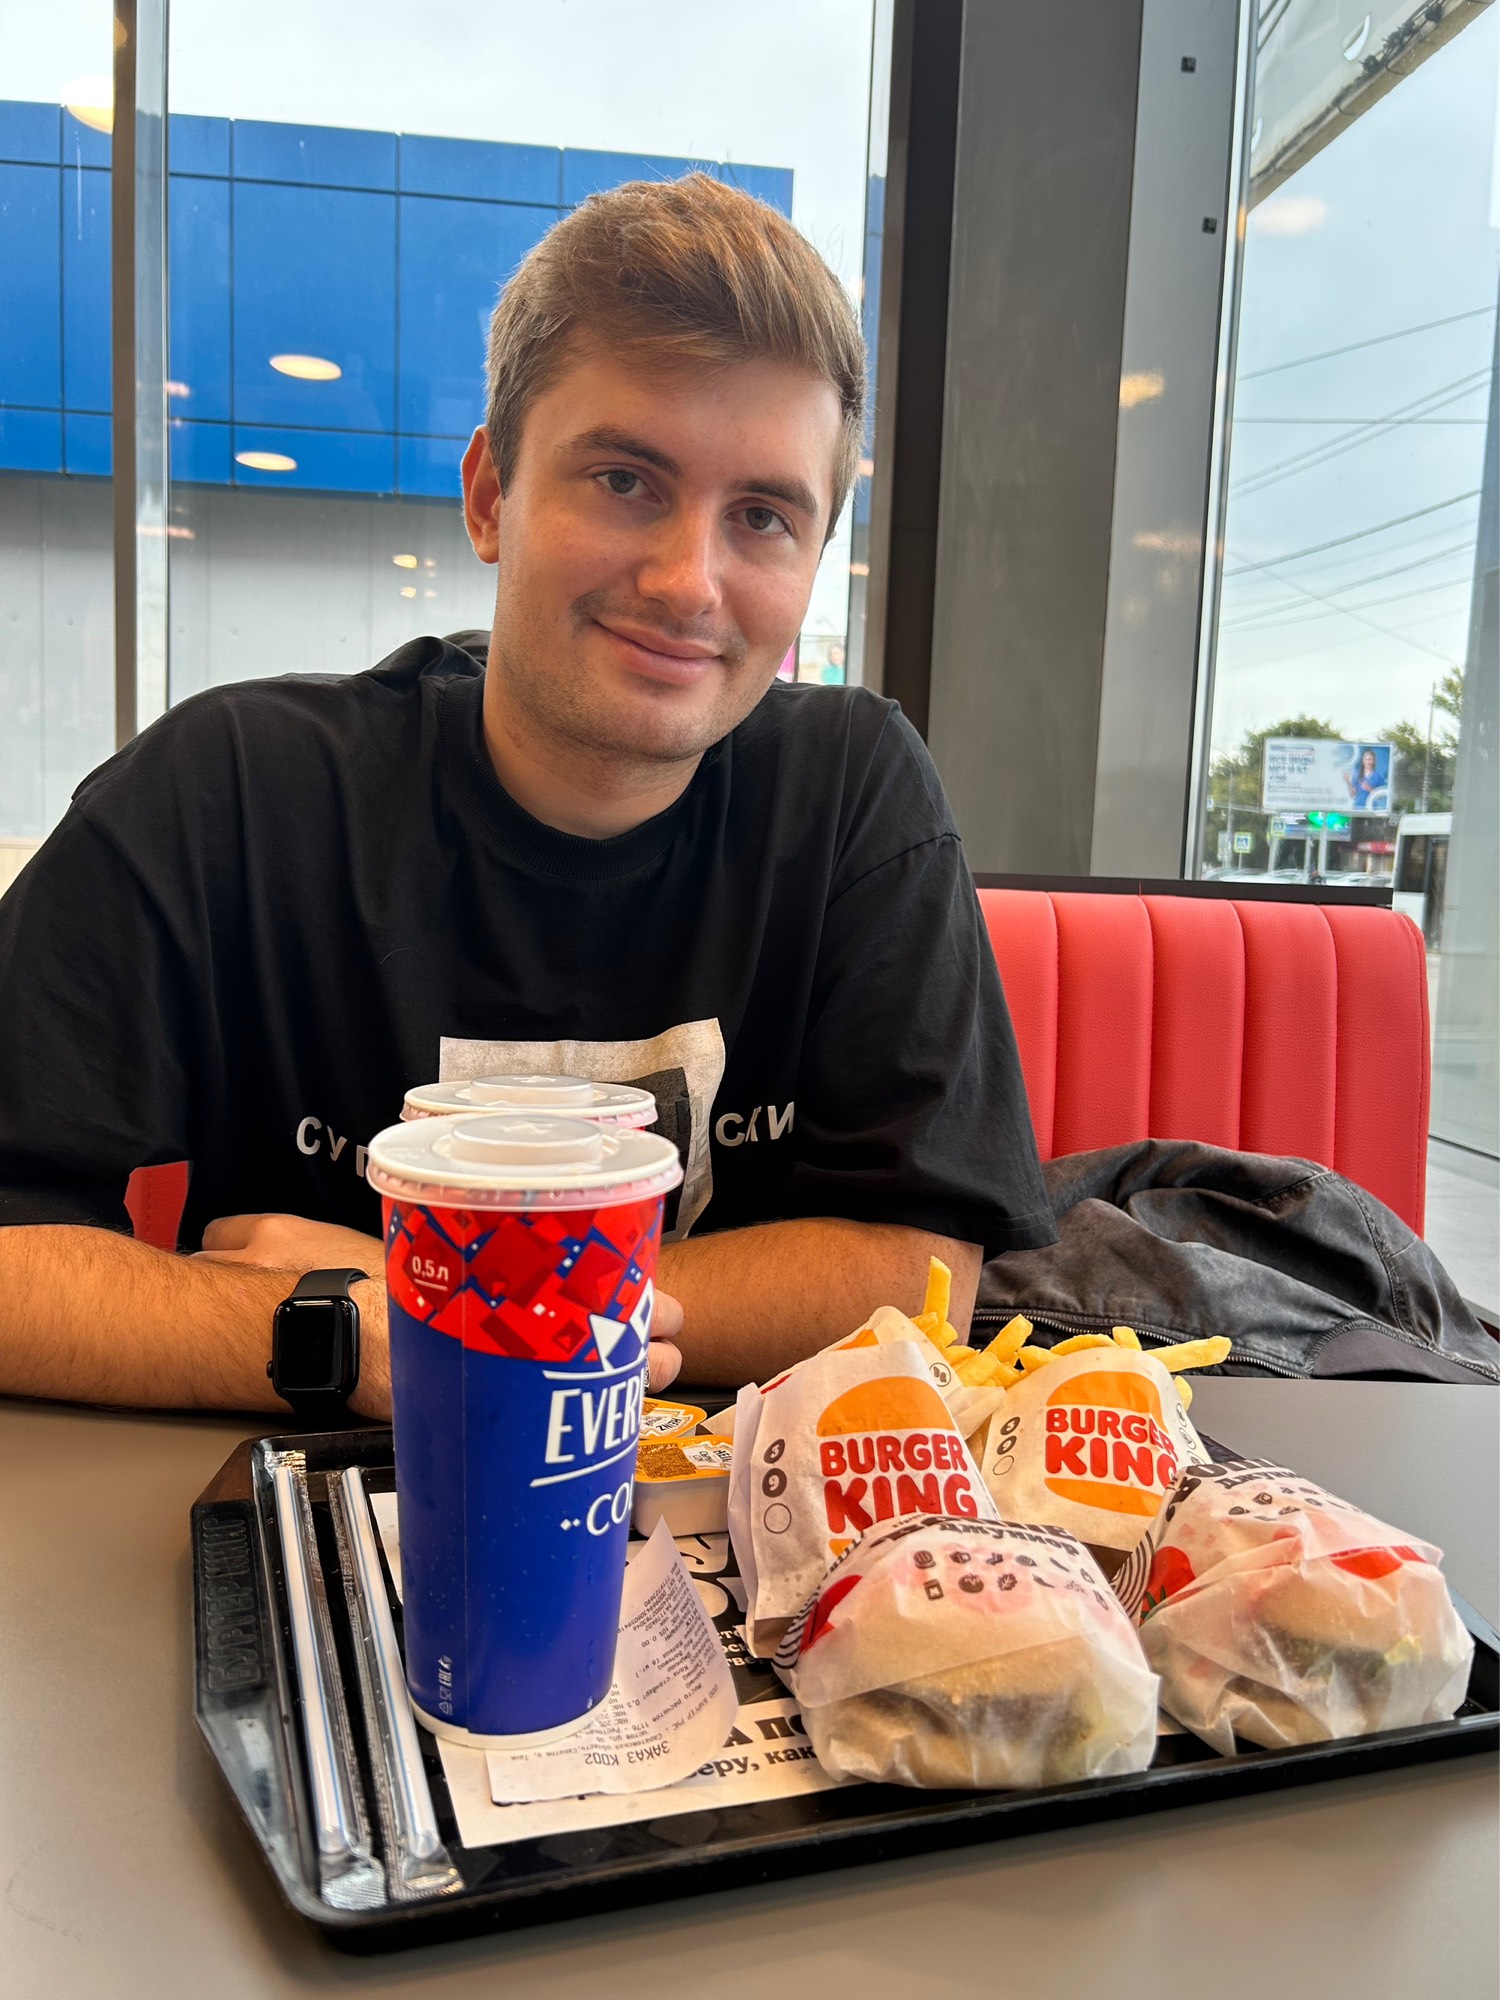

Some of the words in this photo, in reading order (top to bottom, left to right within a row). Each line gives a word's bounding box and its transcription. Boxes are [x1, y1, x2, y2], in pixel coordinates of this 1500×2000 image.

[819, 1433, 969, 1478] BURGER
[1045, 1407, 1179, 1463] BURGER
[1045, 1434, 1178, 1489] KING
[823, 1473, 978, 1534] KING
[625, 1739, 671, 1764] ЗАКАЗ
